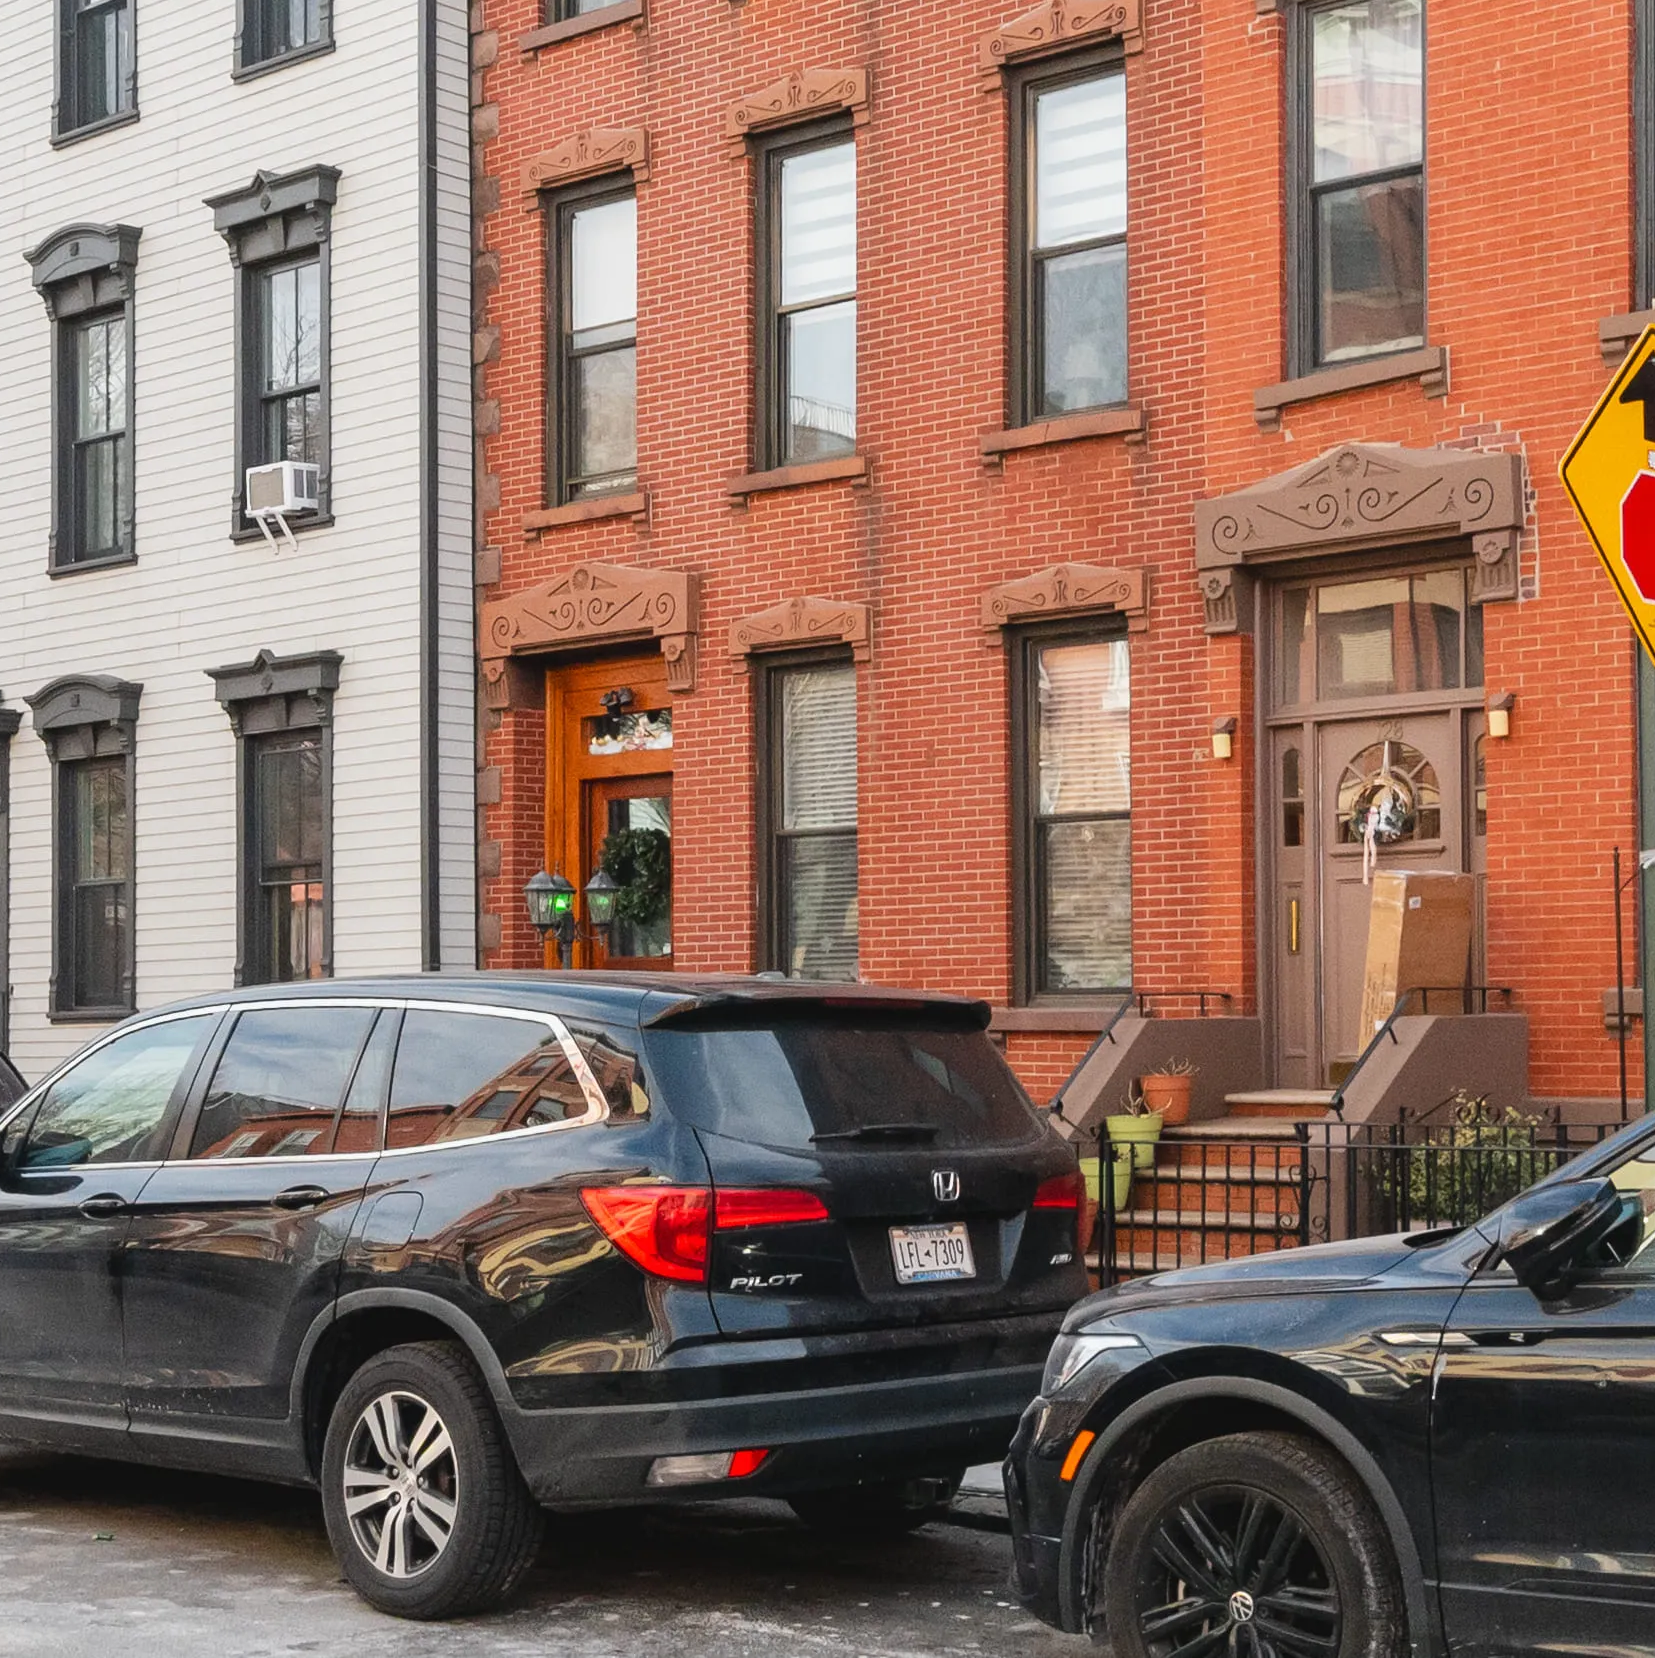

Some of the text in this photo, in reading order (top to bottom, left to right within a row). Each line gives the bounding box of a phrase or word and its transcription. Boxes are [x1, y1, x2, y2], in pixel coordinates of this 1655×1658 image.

[899, 1237, 965, 1270] LFL 7309
[730, 1273, 803, 1290] PILOT
